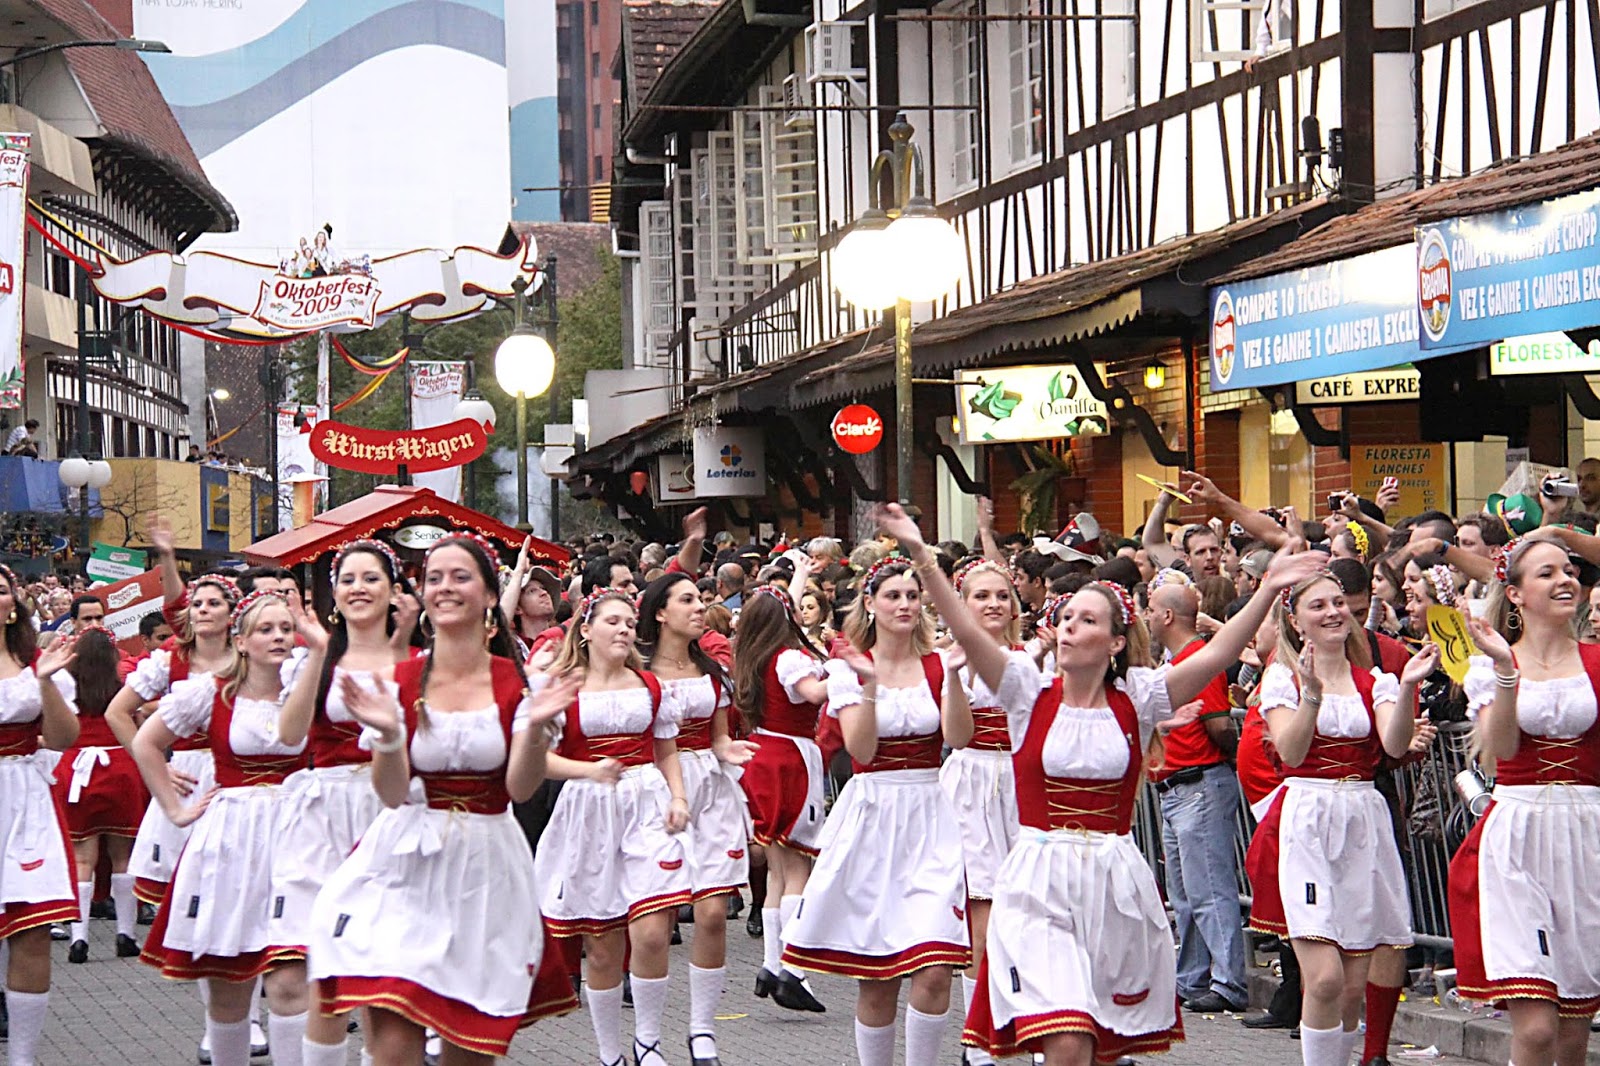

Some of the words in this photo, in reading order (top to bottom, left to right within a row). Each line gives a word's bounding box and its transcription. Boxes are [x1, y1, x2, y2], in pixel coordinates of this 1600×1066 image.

[1562, 211, 1597, 252] CHOPP
[274, 278, 373, 302] Oktoberfest
[1421, 266, 1450, 301] BRAHMA
[1459, 287, 1478, 321] VEZ
[1479, 286, 1486, 318] E
[1487, 280, 1522, 317] GANHE
[1524, 278, 1530, 311] 1
[1532, 269, 1581, 310] CAMISETA
[291, 294, 342, 318] 2009
[1235, 289, 1278, 326] COMPRE
[1281, 287, 1294, 317] 10
[1297, 272, 1340, 315] TICKETS
[1242, 338, 1263, 369] VEZ
[1264, 337, 1271, 366] E
[1273, 329, 1312, 363] GANHE
[1315, 327, 1321, 357] 1
[1324, 316, 1382, 356] CAMISETA
[1310, 376, 1353, 398] CAFÉ
[1364, 377, 1420, 396] EXPRE
[836, 419, 877, 436] Claro
[1366, 448, 1431, 460] FLORESTA
[707, 468, 755, 478] Loterias
[1373, 463, 1425, 474] LANCHES
[414, 531, 443, 540] Senior
